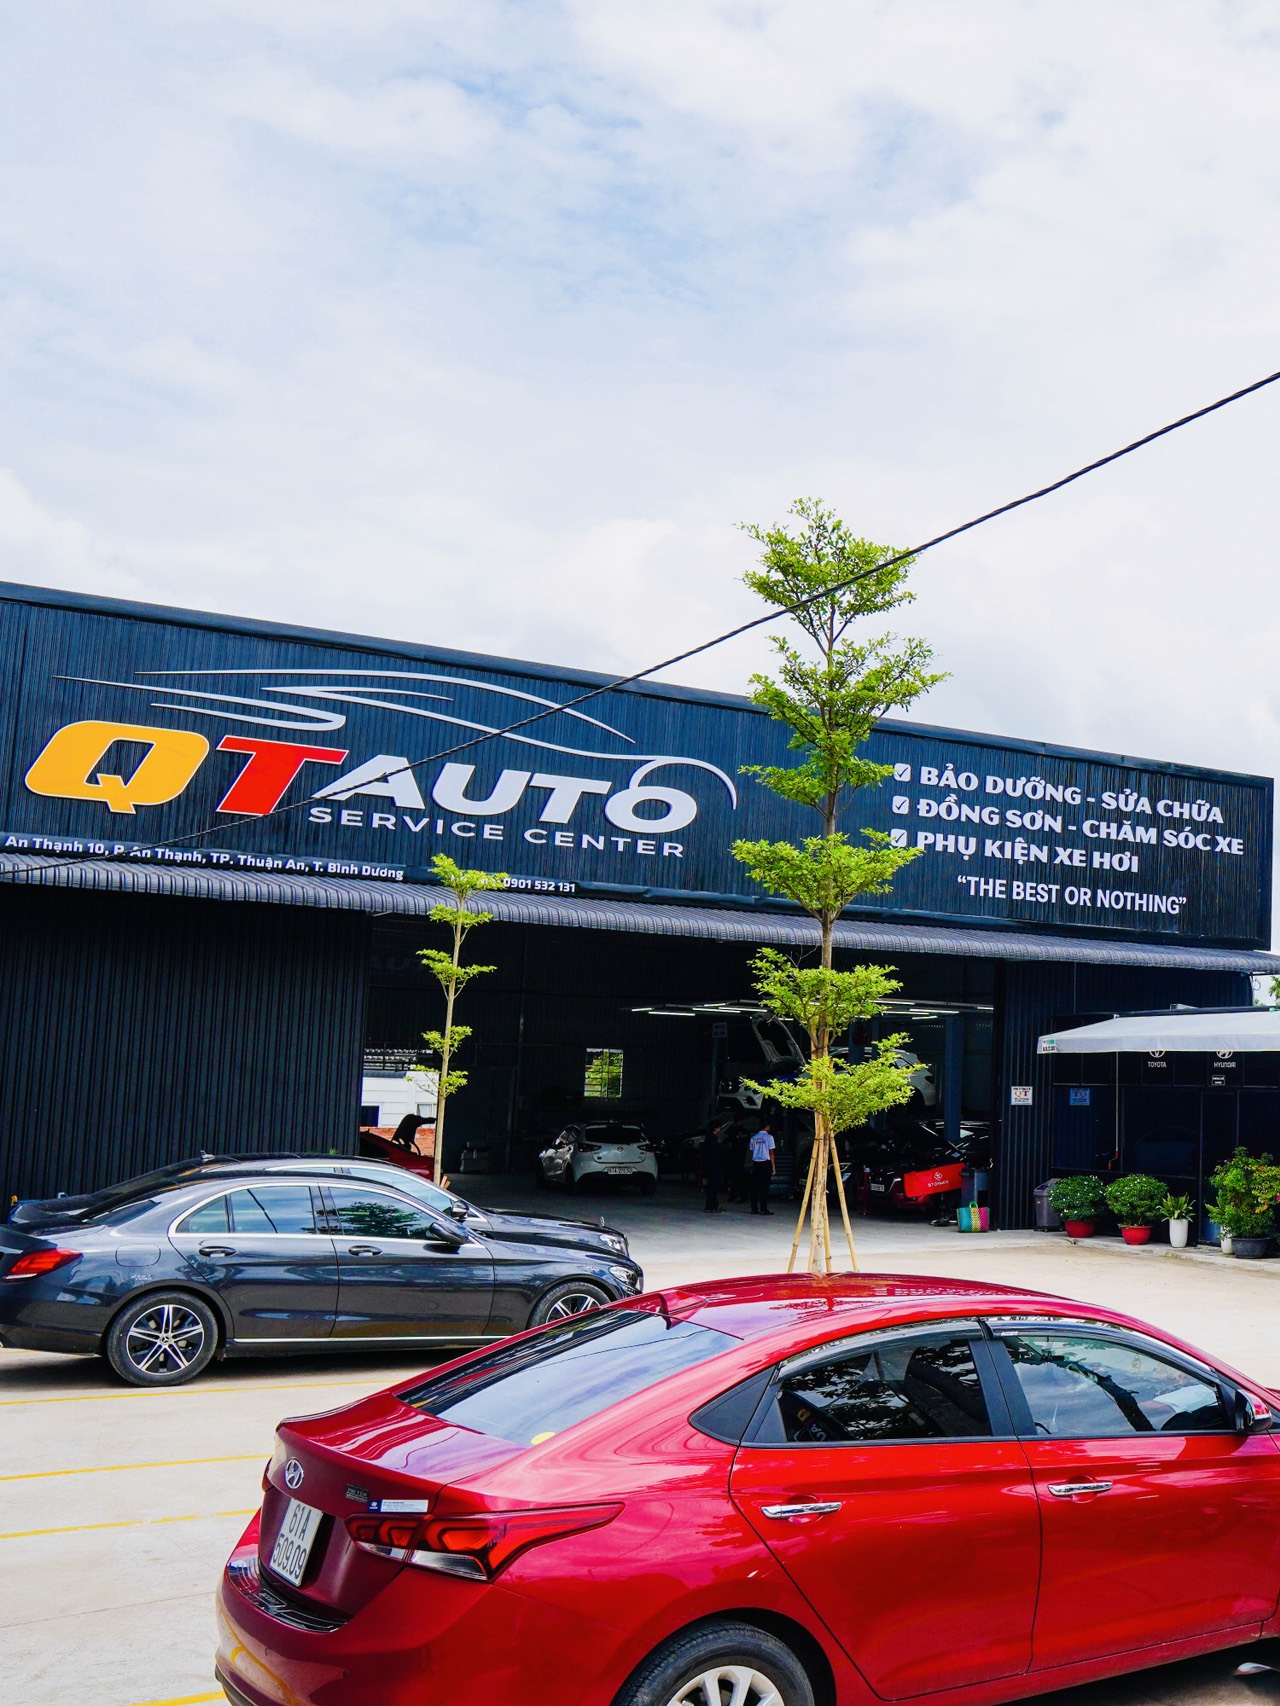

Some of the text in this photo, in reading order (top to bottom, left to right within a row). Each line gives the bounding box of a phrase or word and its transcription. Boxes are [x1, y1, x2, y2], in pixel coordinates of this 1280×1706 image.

[919, 763, 979, 792] BẢO
[985, 776, 1082, 805] DƯỠNG
[1101, 788, 1152, 818] SỬA
[1156, 799, 1224, 825] CHỮA
[308, 807, 684, 858] SERVICE CENTER
[917, 793, 1000, 826] ĐỒNG
[1005, 809, 1062, 834] SƠN
[1082, 814, 1157, 845] CHĂM
[1162, 822, 1212, 852] SÓC
[1215, 836, 1244, 855] XE
[5, 836, 28, 848] An
[32, 837, 83, 853] Thạnh
[155, 848, 206, 864] Thạnh,
[210, 852, 233, 865] TP.
[237, 854, 282, 870] Thuận
[285, 859, 309, 872] An,
[327, 862, 358, 875] Bình
[362, 865, 404, 881] Dương
[917, 830, 1139, 873] PHỤ KIỆN XE HƠI
[534, 880, 555, 891] 532
[557, 882, 576, 893] 131
[1012, 880, 1060, 905] BEST
[1064, 886, 1092, 907] OR
[289, 1503, 312, 1541] 61A
[273, 1533, 307, 1580] 509.09
